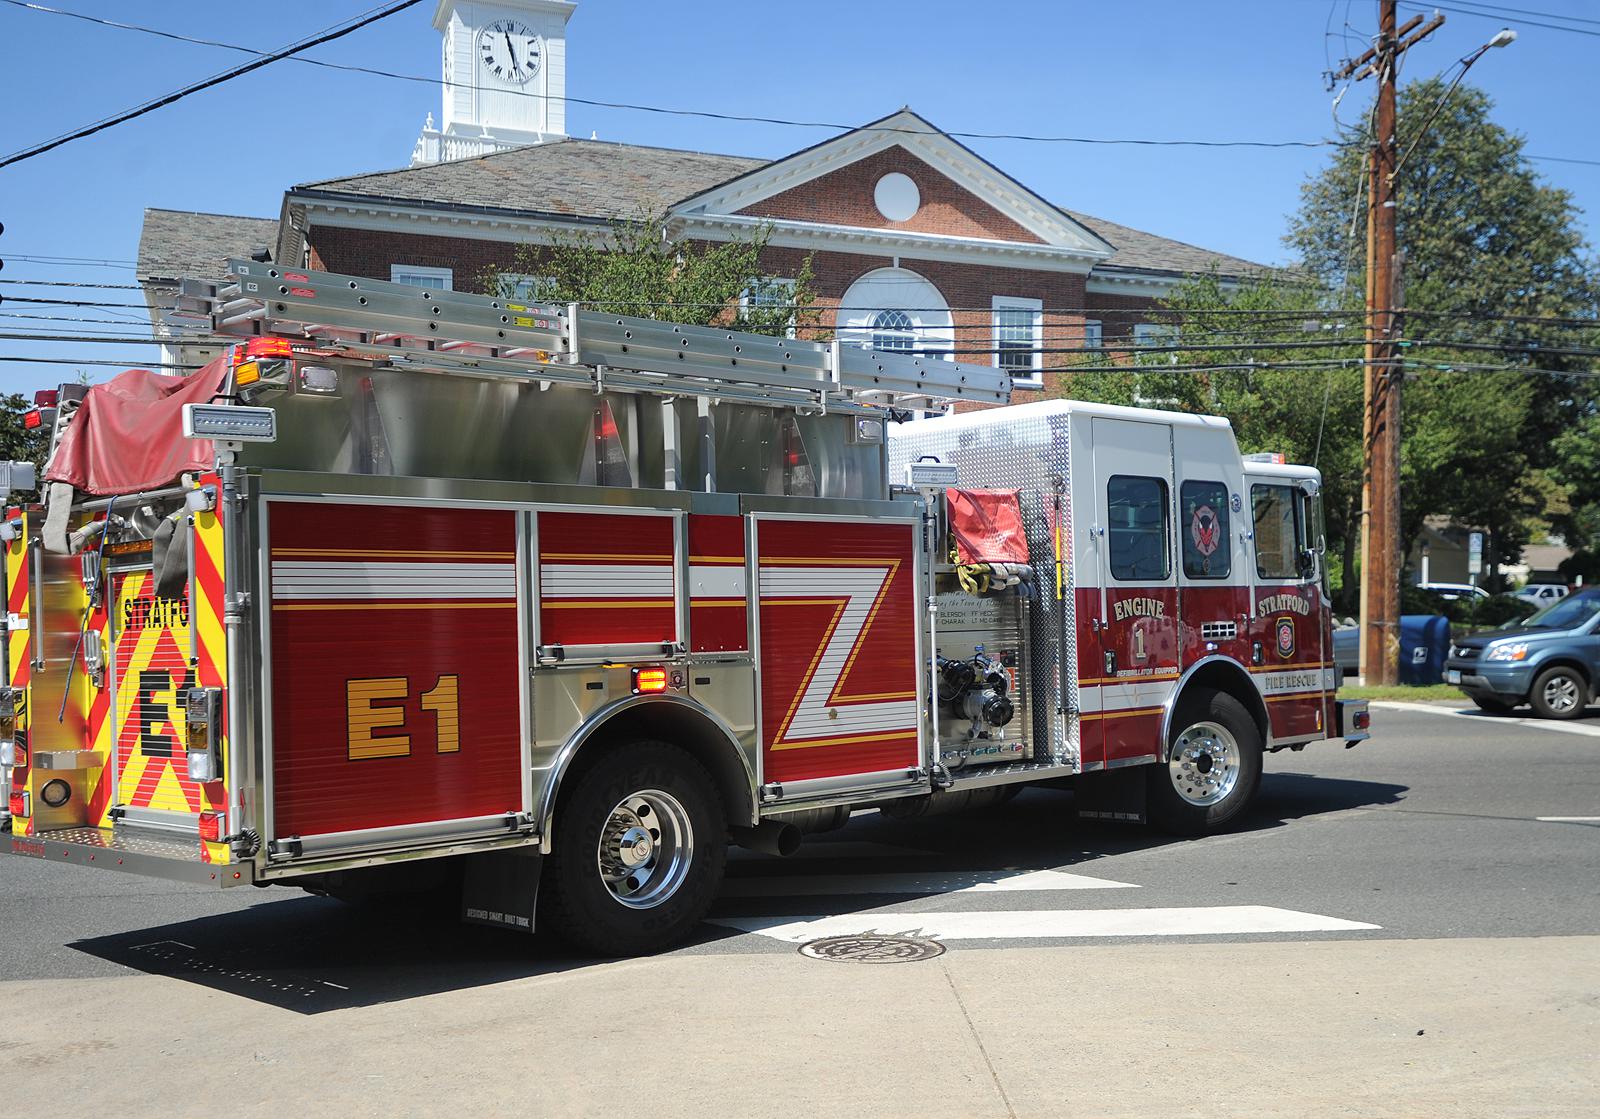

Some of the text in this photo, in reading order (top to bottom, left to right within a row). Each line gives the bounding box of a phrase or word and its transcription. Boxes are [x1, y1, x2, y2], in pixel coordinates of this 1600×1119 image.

[124, 596, 190, 629] STRATFO
[1113, 597, 1165, 621] ENGINE
[1259, 594, 1310, 618] STRATFORD
[1135, 628, 1147, 658] 1
[1265, 674, 1317, 690] FIRE RESCUE
[346, 673, 461, 761] E1
